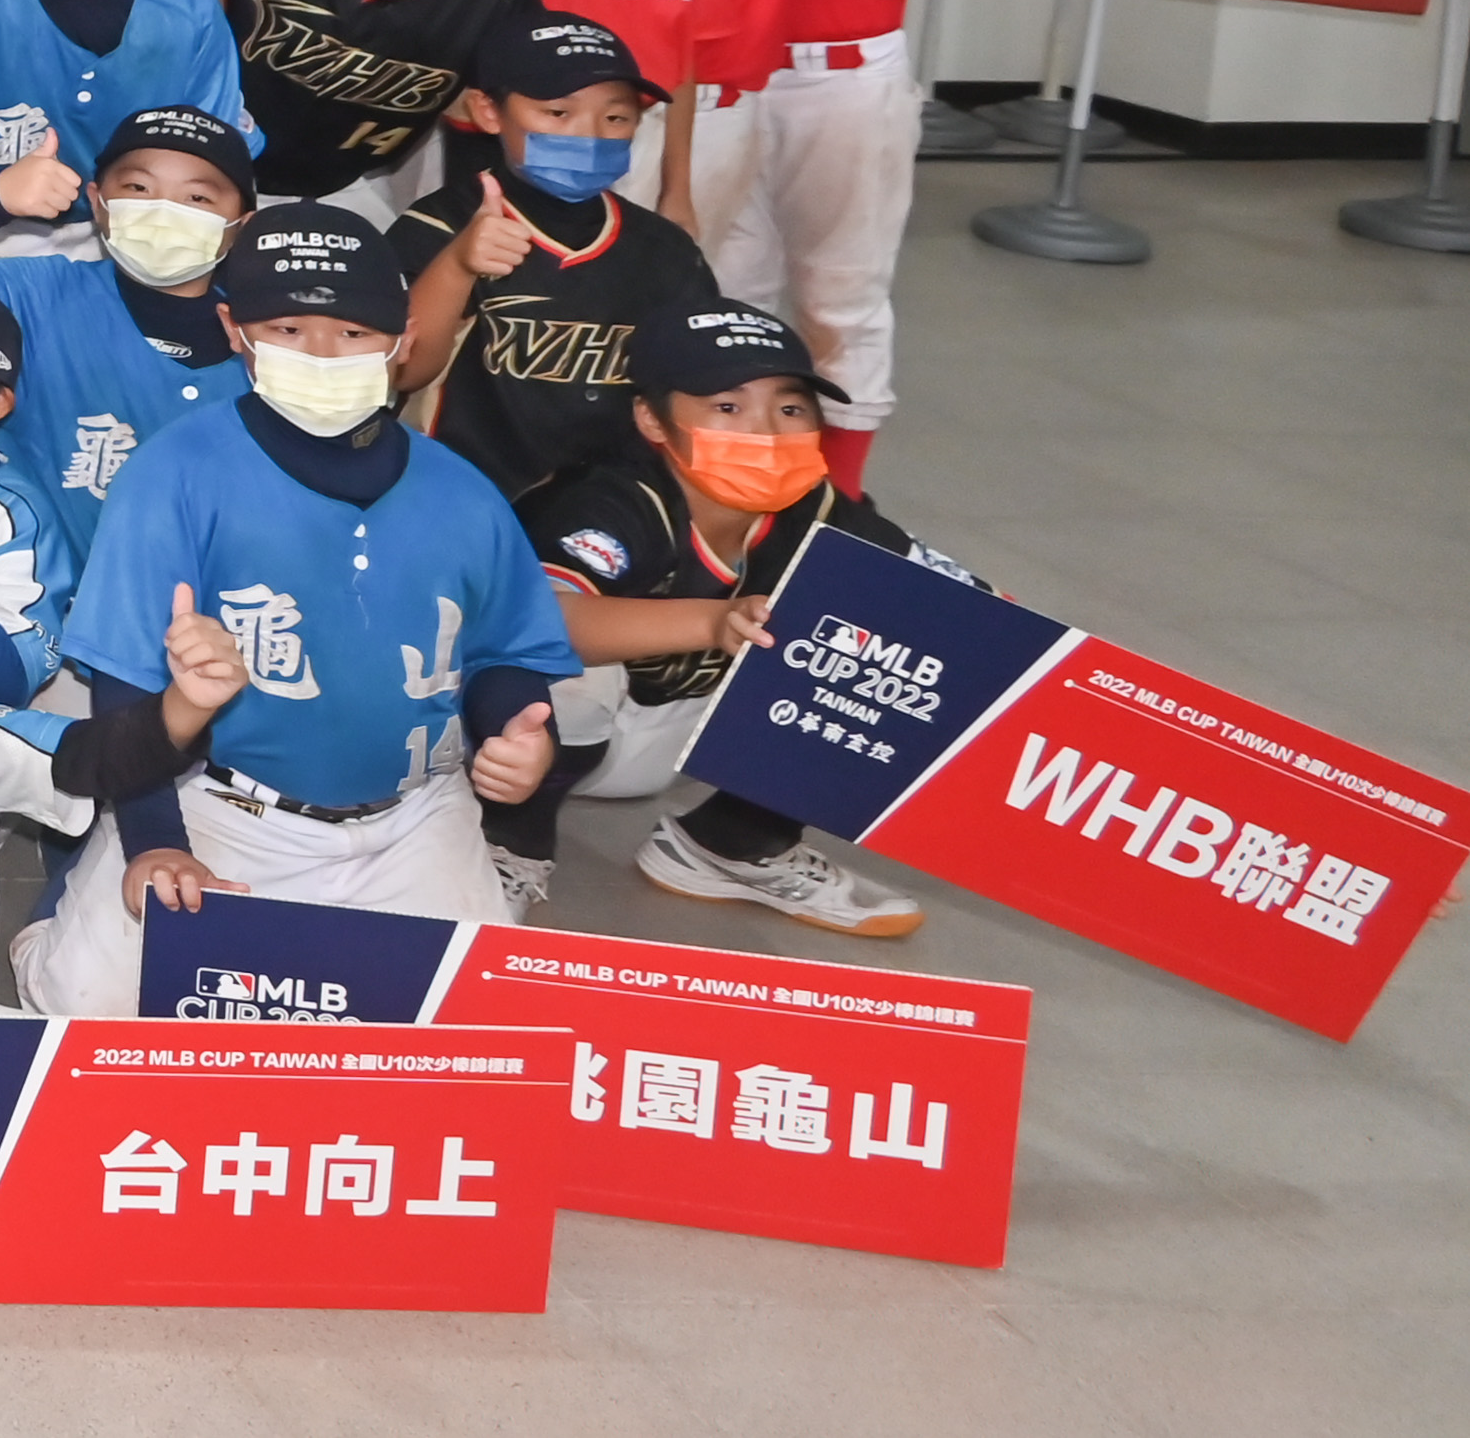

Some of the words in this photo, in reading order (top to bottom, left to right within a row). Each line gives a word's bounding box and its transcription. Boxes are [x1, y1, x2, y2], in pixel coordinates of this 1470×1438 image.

[339, 120, 412, 155] 14
[282, 231, 327, 250] MLB
[327, 232, 363, 254] CUP
[781, 637, 859, 686] CUP
[853, 667, 942, 725] 2022
[861, 633, 946, 689] MLB
[811, 685, 883, 727] TAIWAN
[1003, 732, 1392, 947] WHB聯盟
[99, 1129, 497, 1219] 台中向上
